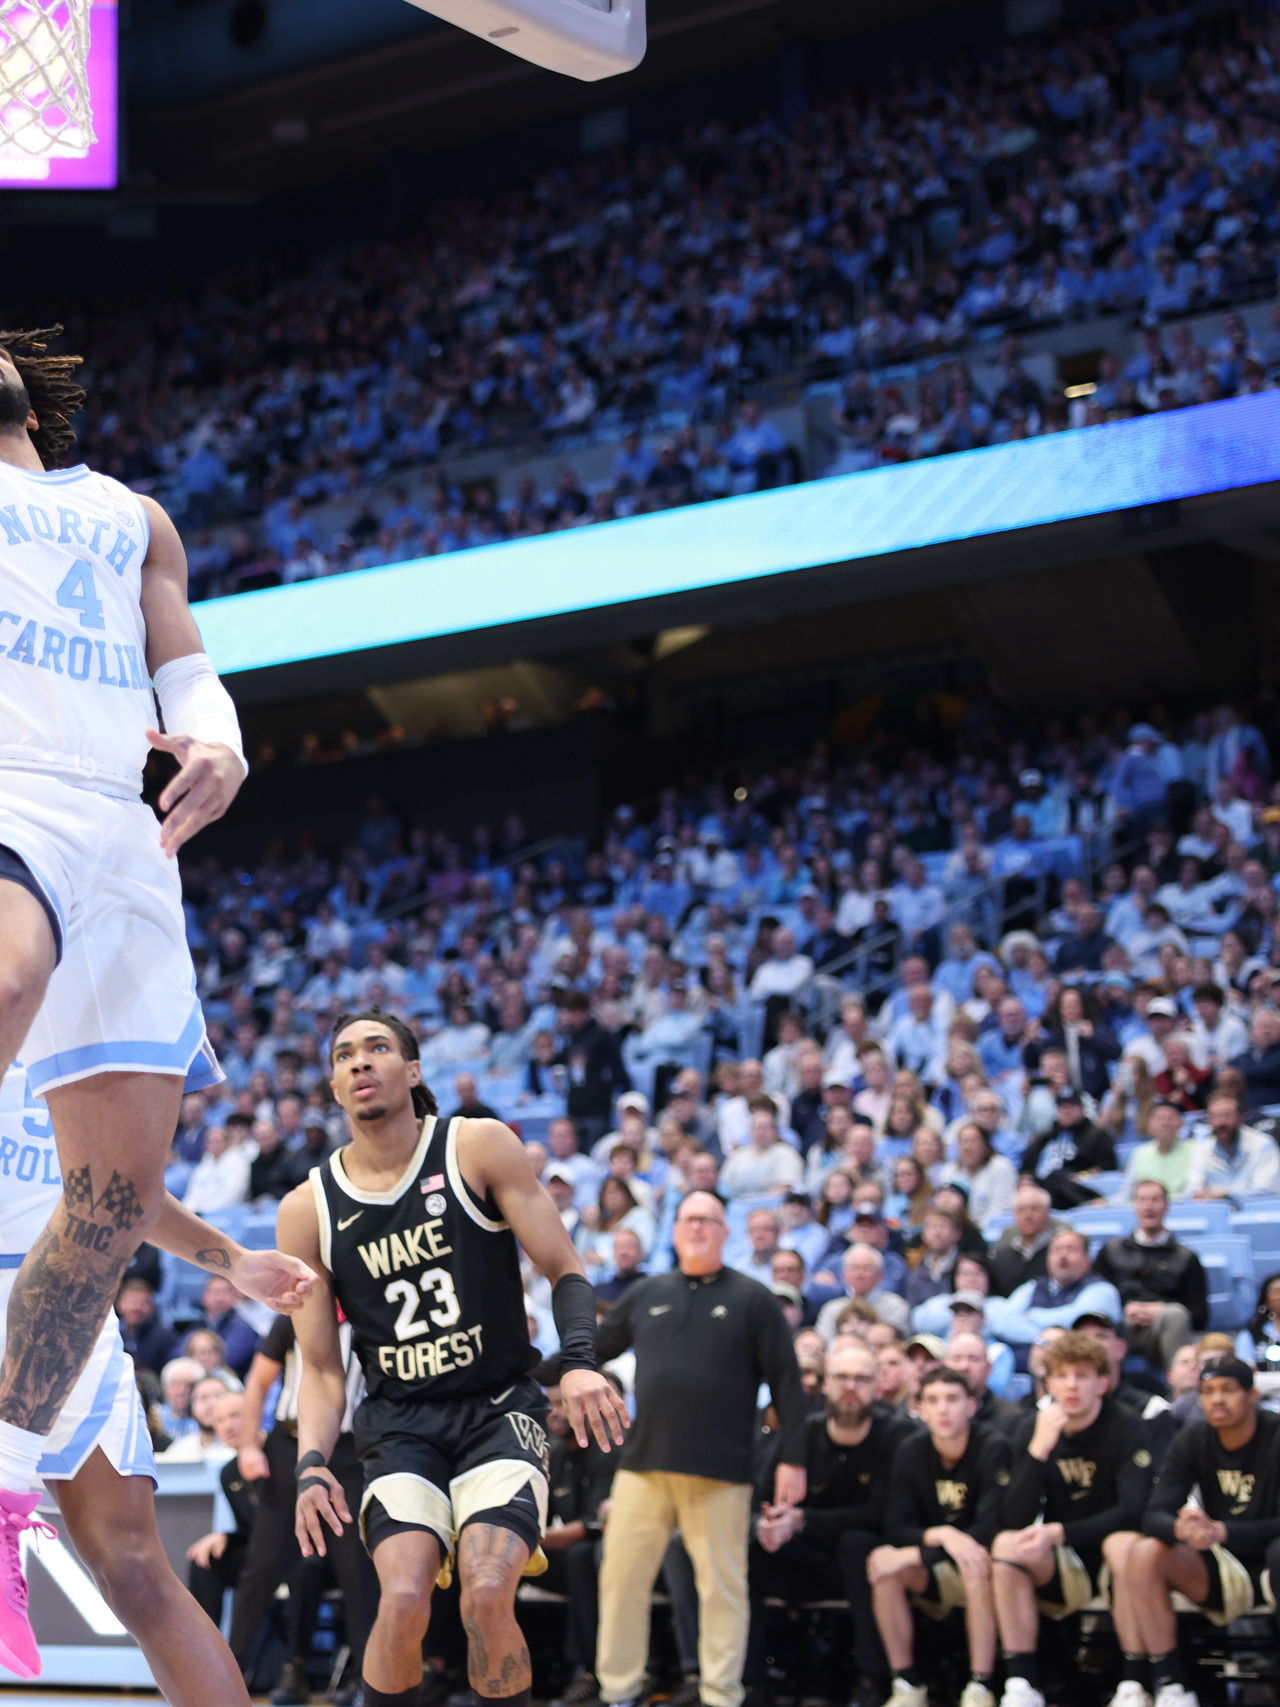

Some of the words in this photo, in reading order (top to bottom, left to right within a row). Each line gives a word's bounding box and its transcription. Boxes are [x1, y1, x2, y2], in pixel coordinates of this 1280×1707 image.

[56, 559, 106, 631] 4
[64, 1212, 115, 1253] TMC
[357, 1218, 453, 1279] WAKE
[384, 1267, 461, 1342] 23
[378, 1324, 483, 1381] FOREST
